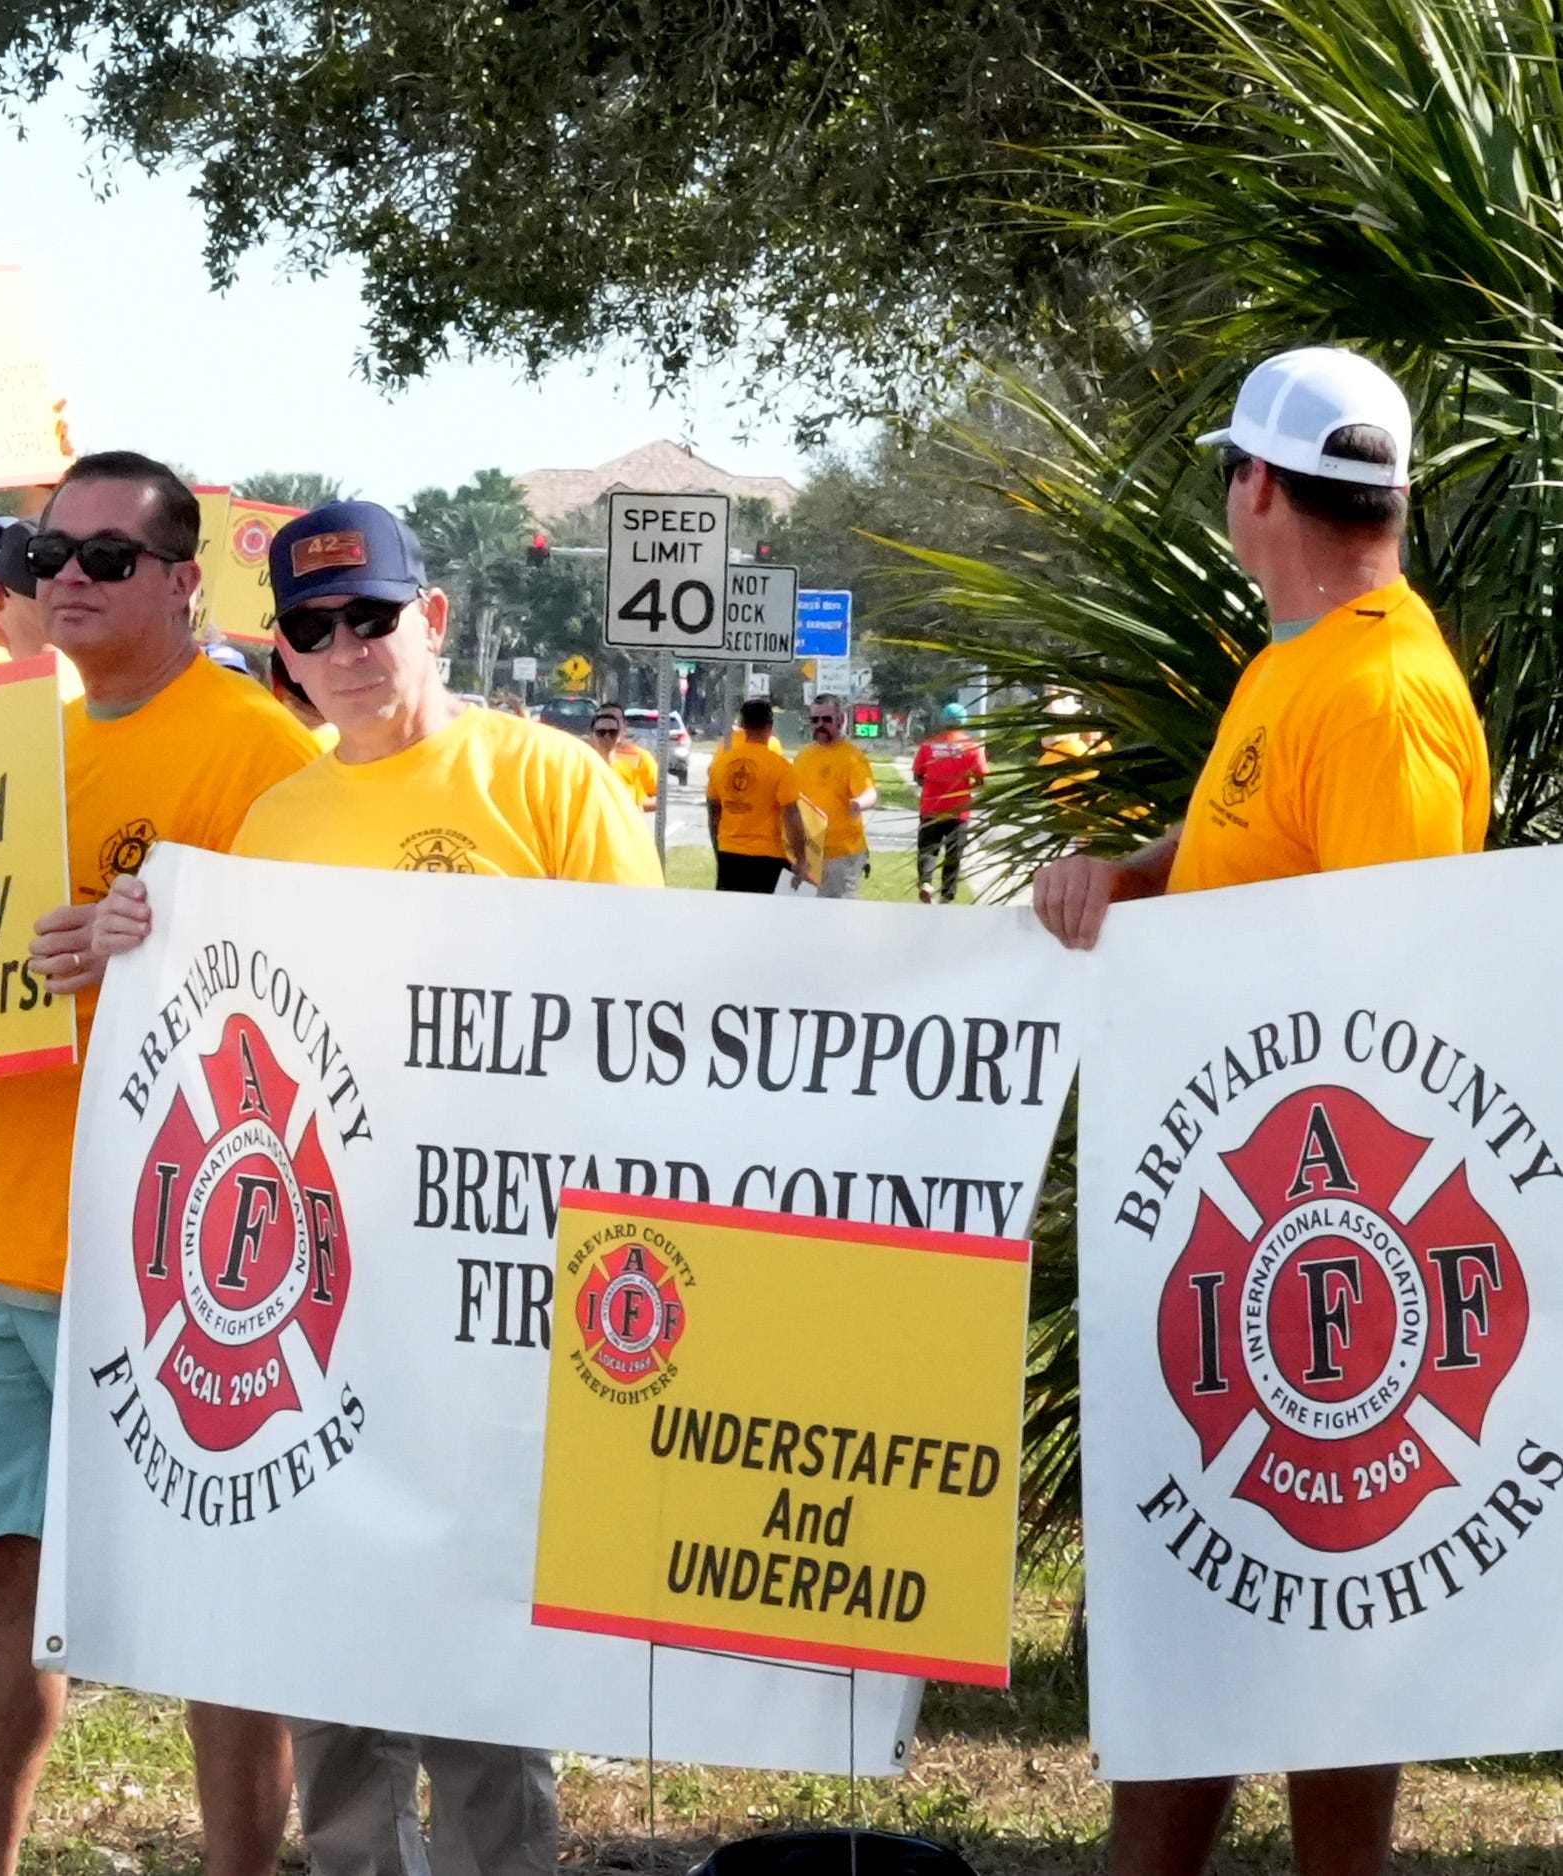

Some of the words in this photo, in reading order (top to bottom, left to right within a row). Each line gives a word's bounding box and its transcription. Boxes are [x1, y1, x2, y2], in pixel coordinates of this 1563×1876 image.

[623, 509, 716, 533] SPEED
[632, 541, 703, 563] LIMIT
[618, 578, 714, 634] 40
[728, 603, 765, 623] OCK
[732, 576, 771, 596] NOT
[726, 632, 788, 653] SECTION
[119, 940, 238, 1121] BREVARD
[250, 950, 374, 1150] COUNTY
[238, 1031, 270, 1119] A
[404, 983, 571, 1077] HELP
[591, 996, 686, 1085] US
[706, 1003, 1060, 1106] SUPPORT
[1115, 1010, 1322, 1243] BREVARD
[1343, 1009, 1563, 1195] COUNTY
[1286, 1102, 1358, 1201] A
[185, 1127, 265, 1257] INTERNATIONAL
[146, 1162, 179, 1280] I
[216, 1174, 279, 1290] F
[305, 1187, 337, 1305] F
[567, 1224, 637, 1276] BREVARD
[643, 1227, 697, 1289] COUNTY
[623, 1247, 647, 1273] A
[190, 1285, 213, 1323] FIRE
[214, 1296, 285, 1336] FIGHTERS
[586, 1293, 597, 1331] I
[621, 1289, 644, 1338] F
[663, 1302, 680, 1341] F
[1247, 1207, 1335, 1362] INTERNATIONAL
[1339, 1209, 1420, 1347] ASSOCIATION
[1190, 1272, 1229, 1396] I
[1298, 1256, 1363, 1384] F
[1428, 1243, 1503, 1371] F
[173, 1344, 222, 1405] LOCAL
[230, 1358, 280, 1406] 2969
[570, 1350, 678, 1405] FIREFIGHTERS
[1271, 1386, 1315, 1424] FIRE
[1314, 1375, 1400, 1430] FIGHTERS
[89, 1345, 367, 1529] FIREFIGHTERS
[651, 1404, 1000, 1498] UNDERSTAFFED
[1260, 1452, 1344, 1504] LOCAL
[1353, 1439, 1421, 1501] 2969
[763, 1487, 854, 1547] And
[1137, 1438, 1563, 1631] FIREFIGHTERS
[667, 1541, 927, 1623] UNDERPAID
